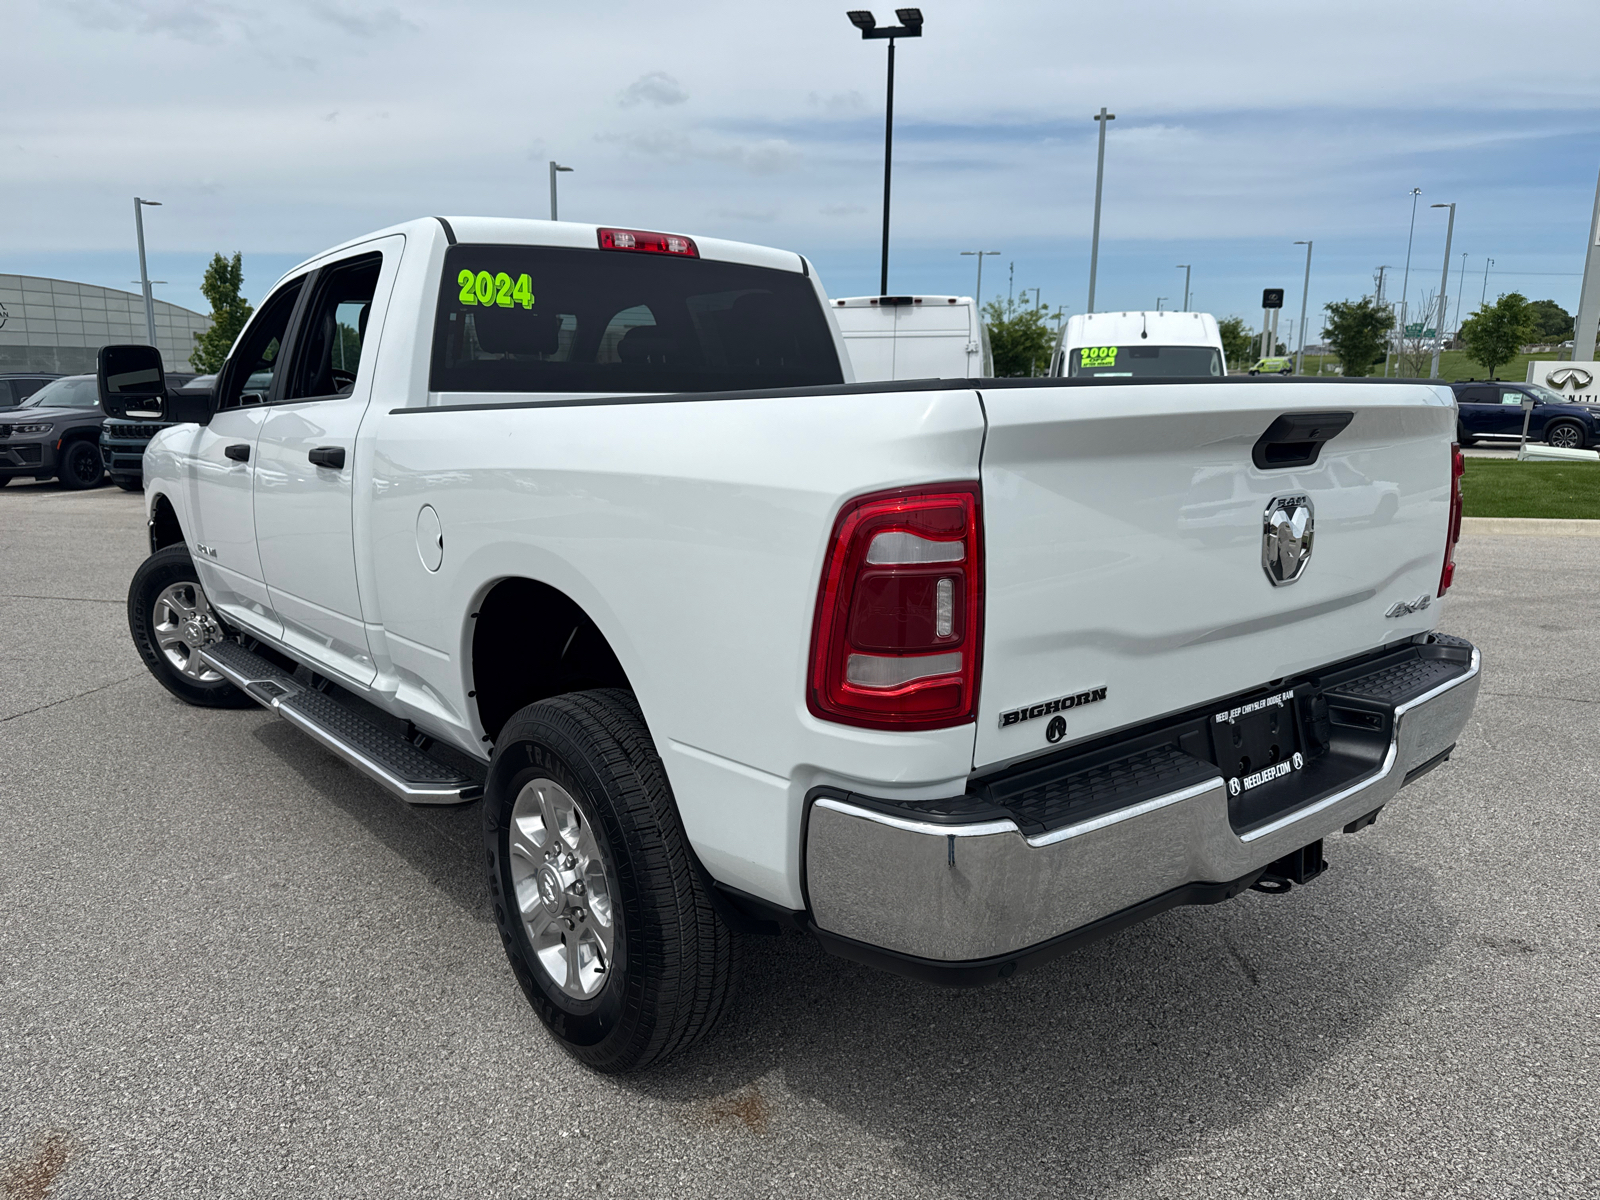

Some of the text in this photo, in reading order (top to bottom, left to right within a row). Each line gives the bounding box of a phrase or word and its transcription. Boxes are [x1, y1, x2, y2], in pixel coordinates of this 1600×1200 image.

[457, 269, 535, 310] 2024
[1081, 347, 1118, 358] 9000
[1278, 496, 1307, 507] RAM
[998, 684, 1108, 729] BIGHORN
[1215, 689, 1294, 723] REED JEEP CHRYSLER DODGE RAM
[1243, 761, 1291, 791] REEDJEEP.COM
